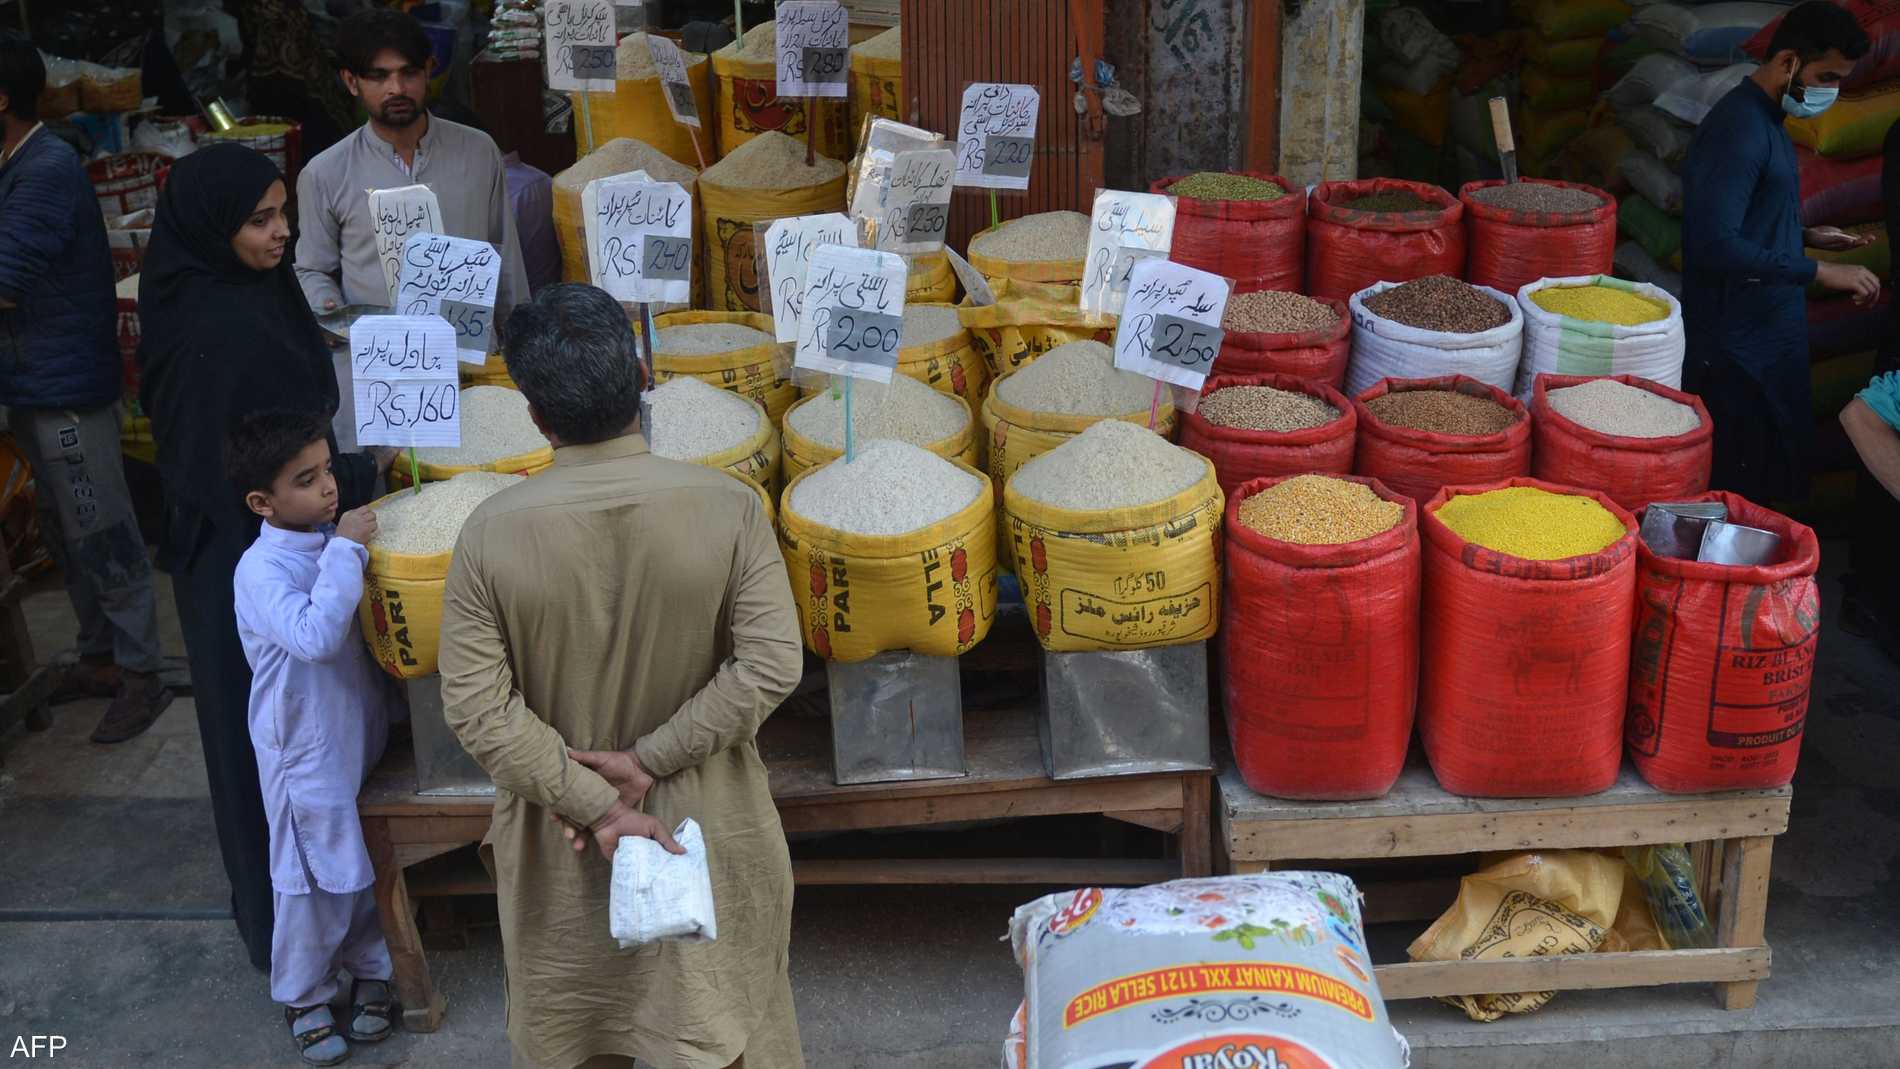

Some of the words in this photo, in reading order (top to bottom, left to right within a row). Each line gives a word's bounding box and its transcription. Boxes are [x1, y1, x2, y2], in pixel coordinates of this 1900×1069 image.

[579, 48, 614, 69] 250
[810, 51, 844, 74] 280
[990, 141, 1031, 167] 220
[648, 239, 689, 271] 240
[832, 314, 899, 353] 200
[1156, 323, 1216, 366] 250
[830, 556, 851, 633] PARI
[920, 548, 946, 627] ELLA
[1144, 570, 1166, 593] 50
[386, 589, 418, 667] PARI
[1731, 655, 1766, 669] RIZ
[1109, 976, 1157, 1005] SELLA
[1160, 969, 1199, 995] 1121
[1200, 967, 1232, 987] XXL
[1235, 967, 1296, 989] KAINAT
[1074, 989, 1107, 1018] RICE
[1295, 970, 1366, 1015] PREMIUM
